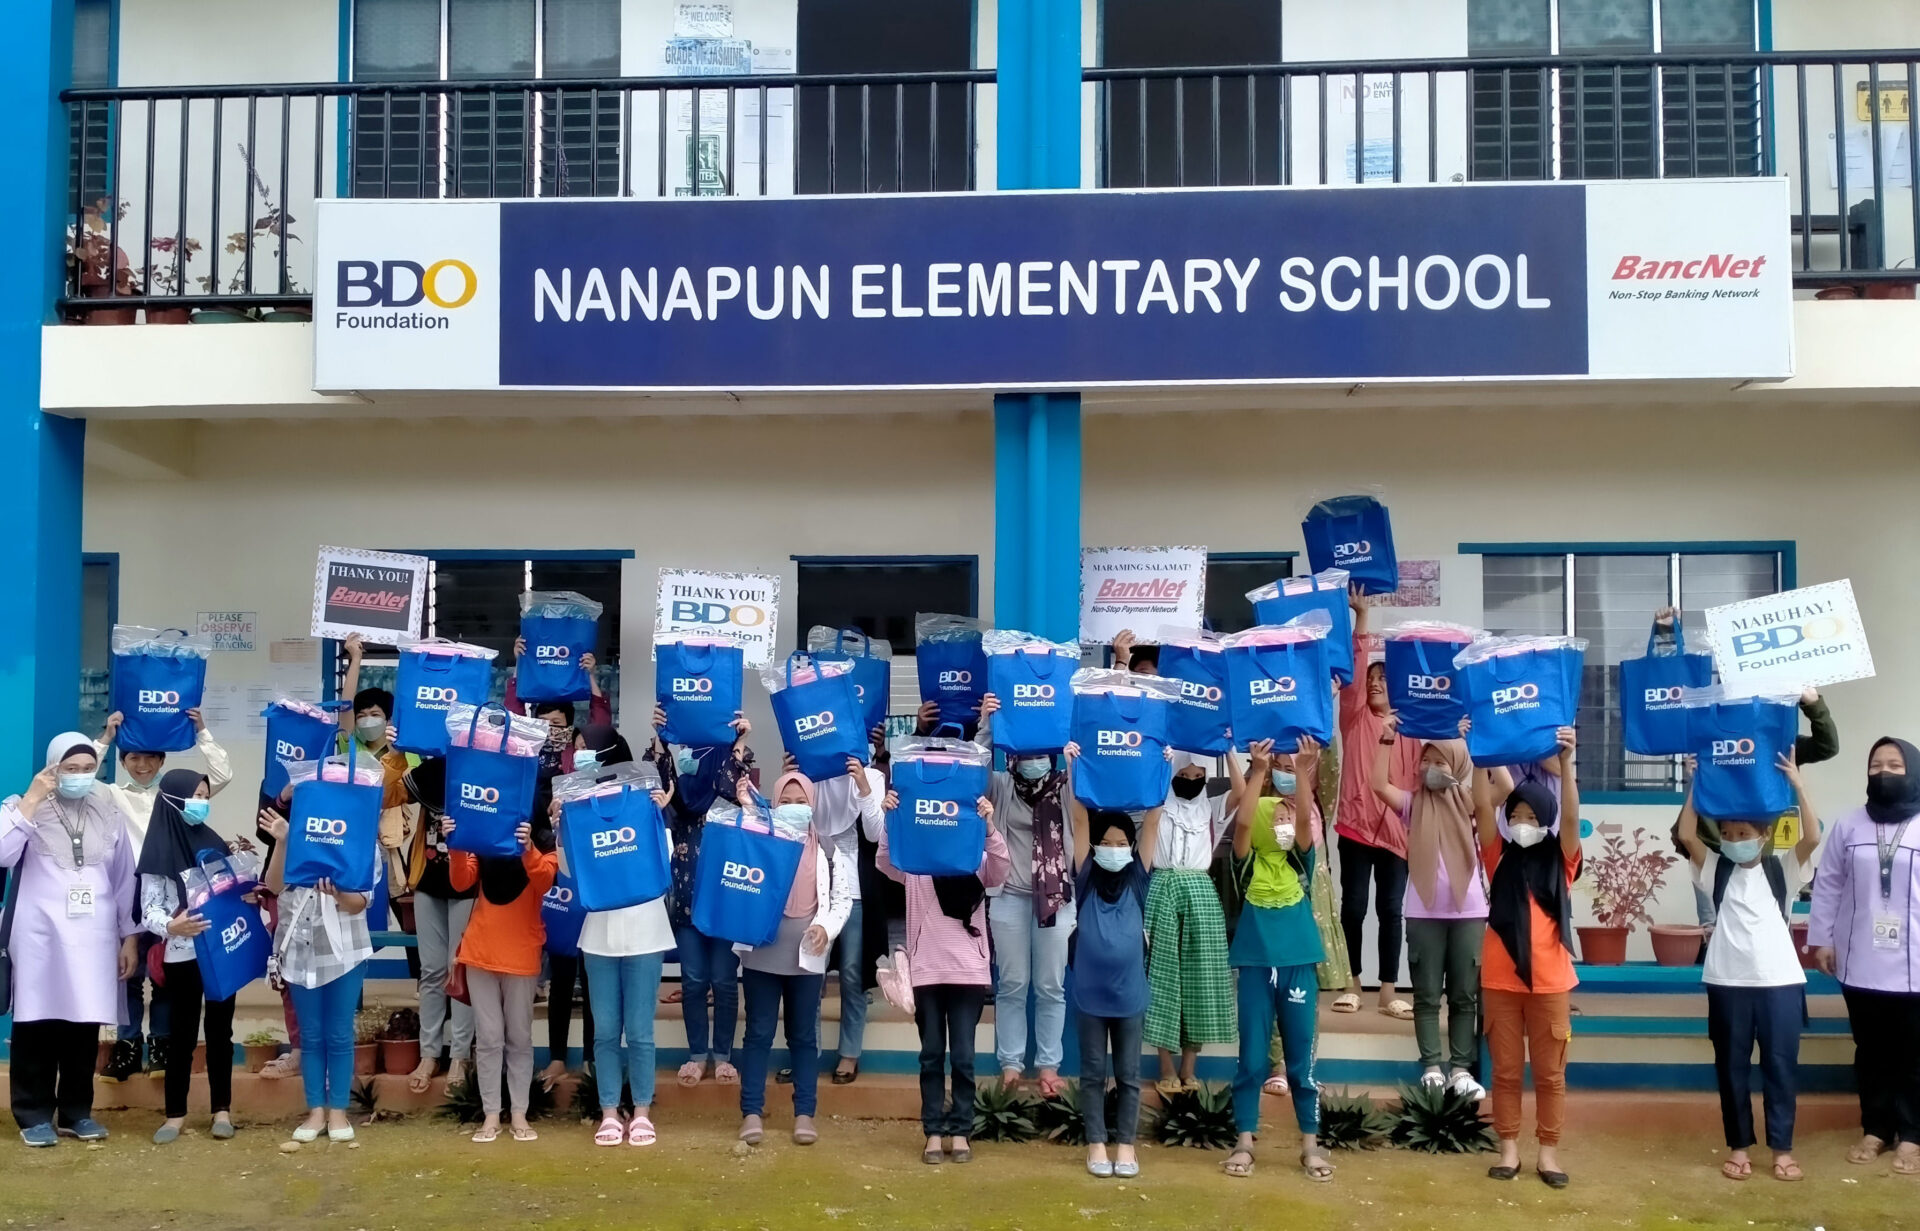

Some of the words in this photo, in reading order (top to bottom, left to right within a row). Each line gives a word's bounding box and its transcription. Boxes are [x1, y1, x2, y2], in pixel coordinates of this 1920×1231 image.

[1373, 81, 1393, 90] MAS
[1611, 254, 1767, 280] BancNet
[336, 259, 477, 308] BDO
[534, 265, 830, 322] NANAPUN
[852, 257, 1260, 318] ELEMENTARY
[1279, 254, 1551, 312] SCHOOL
[1608, 290, 1661, 301] Non-Stop
[1664, 289, 1709, 300] Banking
[1712, 288, 1760, 298] Network
[336, 312, 449, 329] Foundation
[1334, 540, 1371, 558] BDO
[1093, 564, 1143, 572] MARAMING
[1145, 563, 1191, 571] SALAMAT!
[1335, 555, 1373, 567] Foundation
[330, 565, 374, 580] THANK
[378, 569, 409, 583] YOU!
[672, 585, 725, 600] THANK
[729, 589, 765, 602] YOU!
[1097, 578, 1187, 597] BancNet
[329, 586, 409, 608] BancNet
[209, 613, 243, 622] PLEASE
[671, 600, 766, 627] BDO
[1091, 605, 1121, 614] Non-Stop
[1121, 606, 1150, 614] Payment
[1150, 605, 1178, 613] Network
[1732, 600, 1833, 632] MABUHAY!
[201, 623, 252, 632] OBSERVE
[1732, 616, 1846, 657] BDO
[536, 646, 570, 658] BDO
[1738, 643, 1852, 672] Foundation
[673, 678, 713, 692] BDO
[939, 671, 972, 684] BDO
[1408, 675, 1450, 691] BDO
[1014, 684, 1055, 698] BDO
[1181, 681, 1222, 702] BDO
[1250, 676, 1296, 696] BDO
[1645, 686, 1683, 702] BDO
[139, 690, 180, 705] BDO
[417, 686, 458, 703] BDO
[673, 694, 712, 702] Foundation
[1251, 695, 1297, 706] Foundation
[1408, 691, 1450, 700] Foundation
[1492, 683, 1539, 706] BDO
[139, 705, 181, 713] Foundation
[416, 702, 451, 711] Foundatio
[1014, 699, 1055, 707] Foundation
[1179, 696, 1219, 711] Foundation
[1494, 701, 1540, 715] Foundation
[795, 711, 834, 734] BDO
[799, 726, 837, 742] Foundation
[1098, 730, 1142, 747] BDO
[276, 740, 305, 761] BDO
[1097, 748, 1142, 757] Foundation
[1712, 738, 1755, 756] BDO
[1713, 758, 1755, 766] Foundation
[461, 783, 500, 803] BDO
[461, 800, 499, 814] Foundation
[916, 799, 959, 817] BDO
[306, 817, 347, 835] BDO
[915, 817, 958, 827] Foundation
[306, 834, 344, 846] Foundation
[592, 827, 636, 848] BDO
[595, 843, 638, 859] Foundation
[723, 861, 766, 884] BDO
[721, 877, 762, 895] Foundation
[543, 886, 573, 903] DO
[221, 917, 248, 946] BDO
